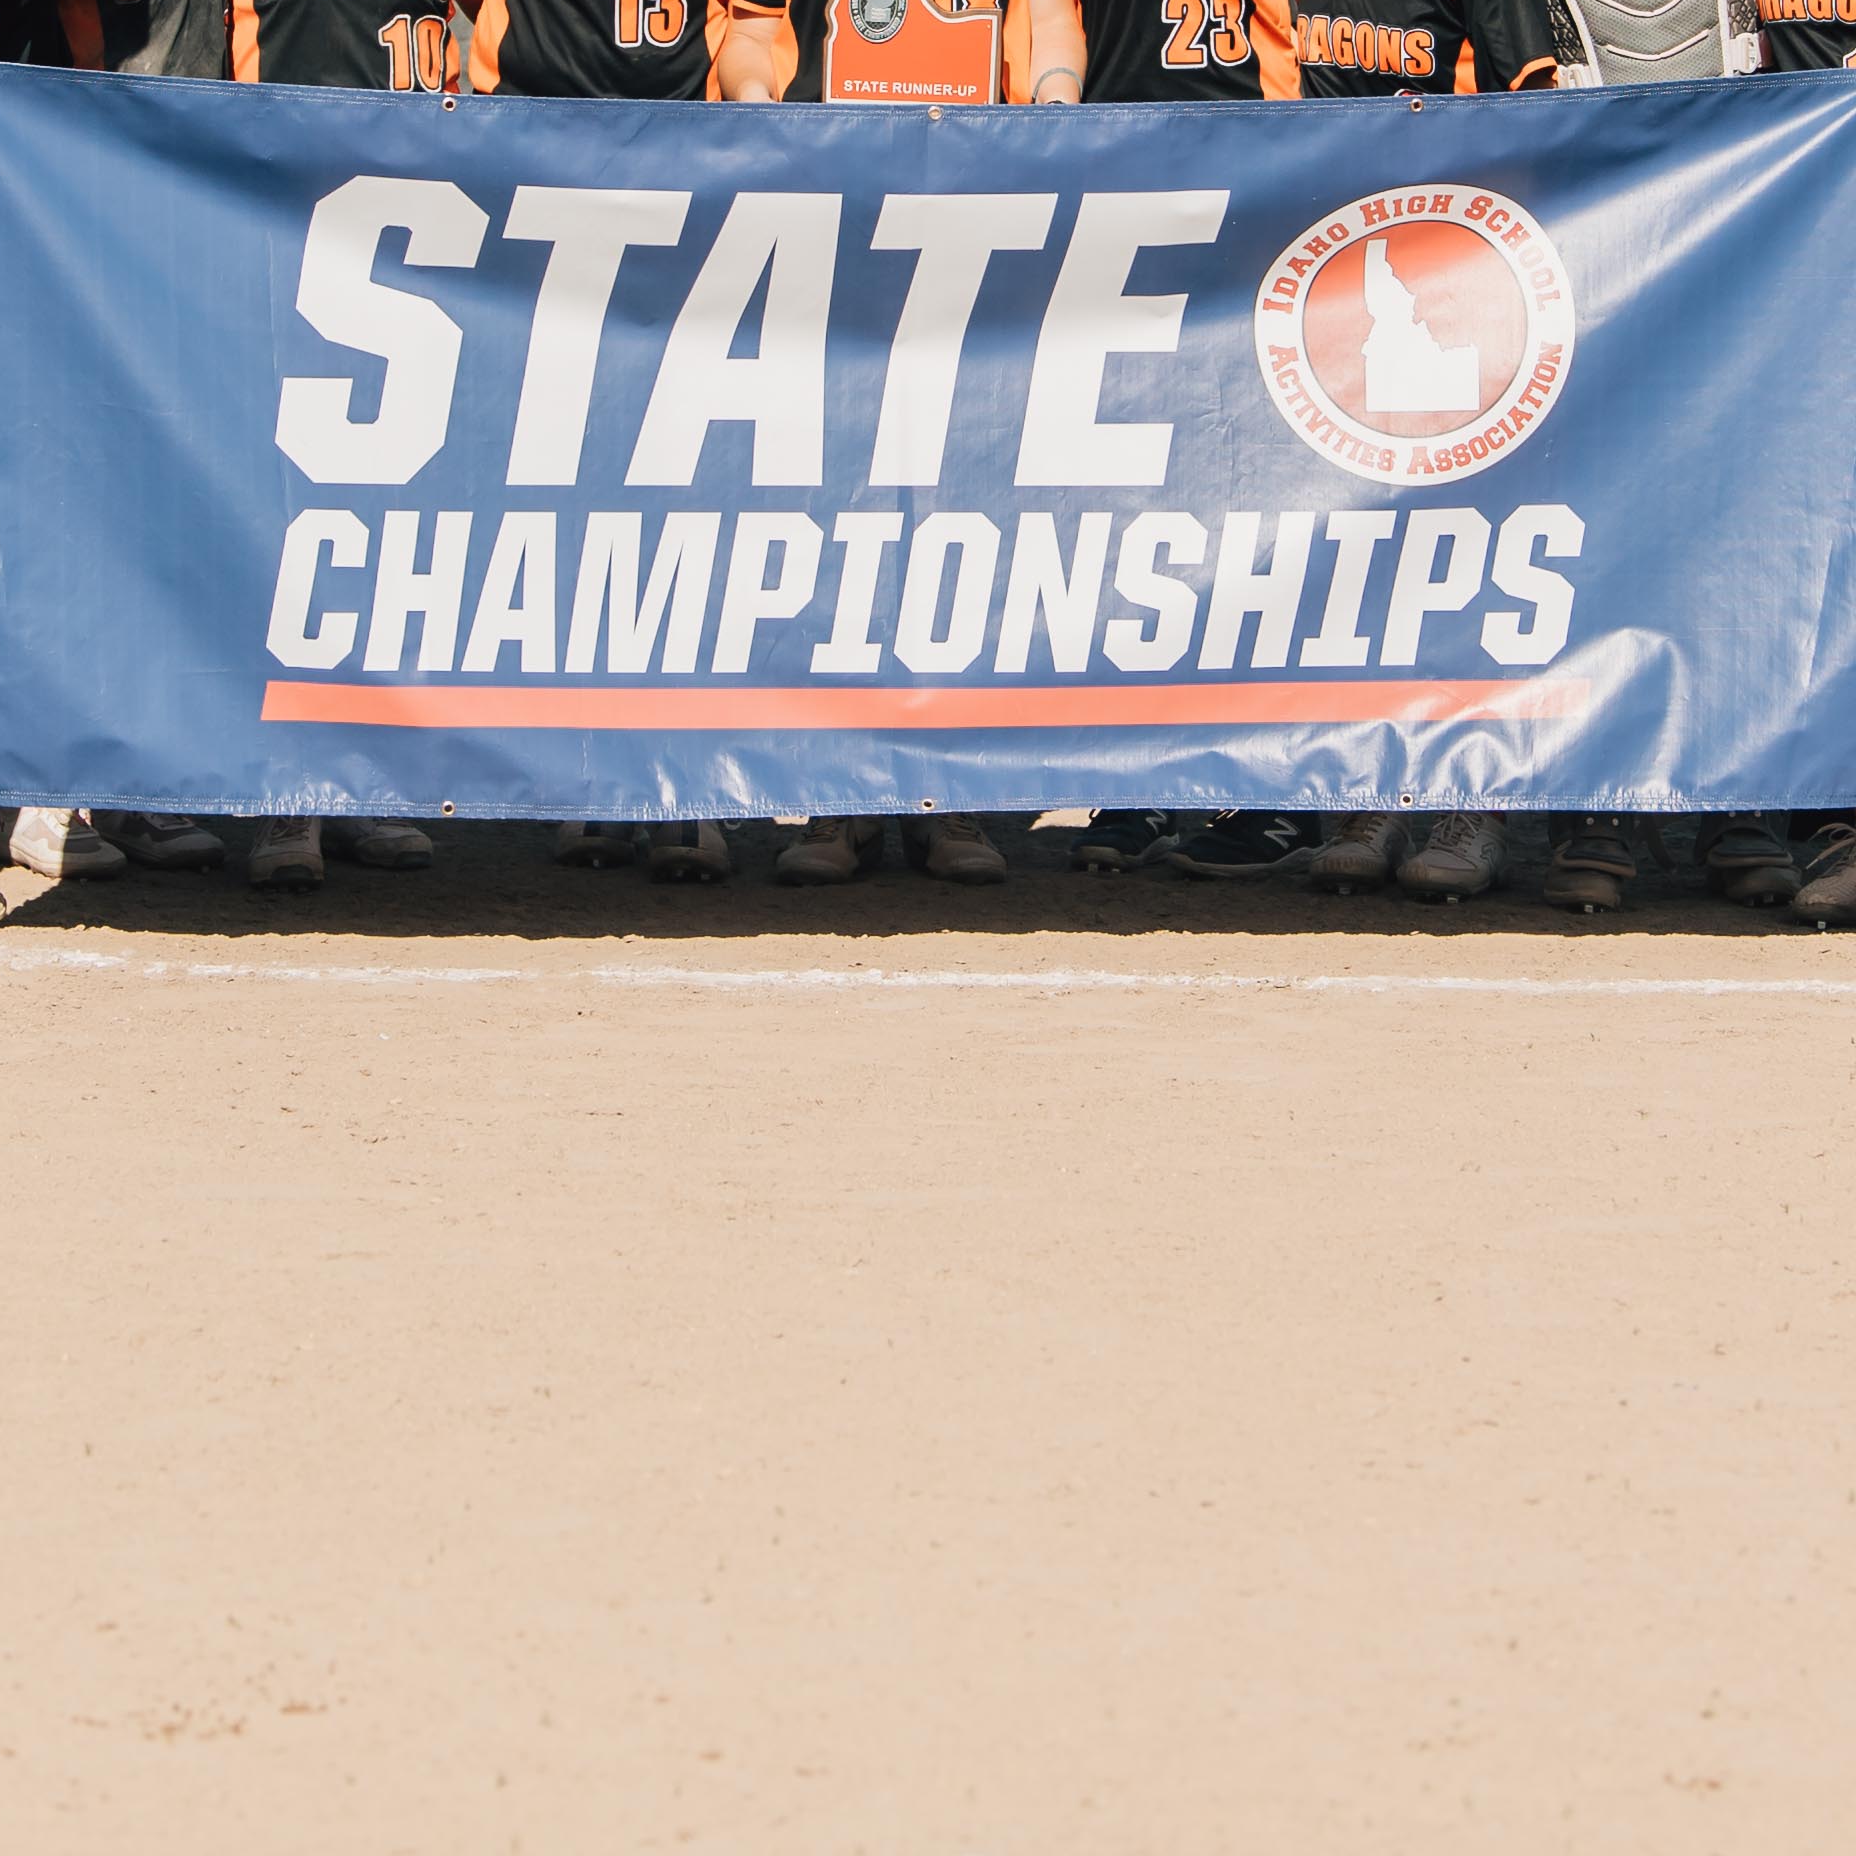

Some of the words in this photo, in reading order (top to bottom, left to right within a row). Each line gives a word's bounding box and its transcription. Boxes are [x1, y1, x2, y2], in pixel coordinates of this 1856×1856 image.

[378, 14, 447, 93] 10
[844, 80, 888, 94] STATE
[892, 82, 977, 98] RUNNER-UP
[1297, 14, 1435, 77] RAGONS
[1263, 222, 1350, 314] IDAHO
[1360, 194, 1454, 226] HIGH
[1464, 195, 1561, 312] SCHOOL
[274, 175, 1231, 486] STATE
[1268, 344, 1396, 472] ACTIVITIES
[1407, 341, 1563, 475] ASSOCIATION
[266, 504, 1586, 674] CHAMPIONSHIPS
